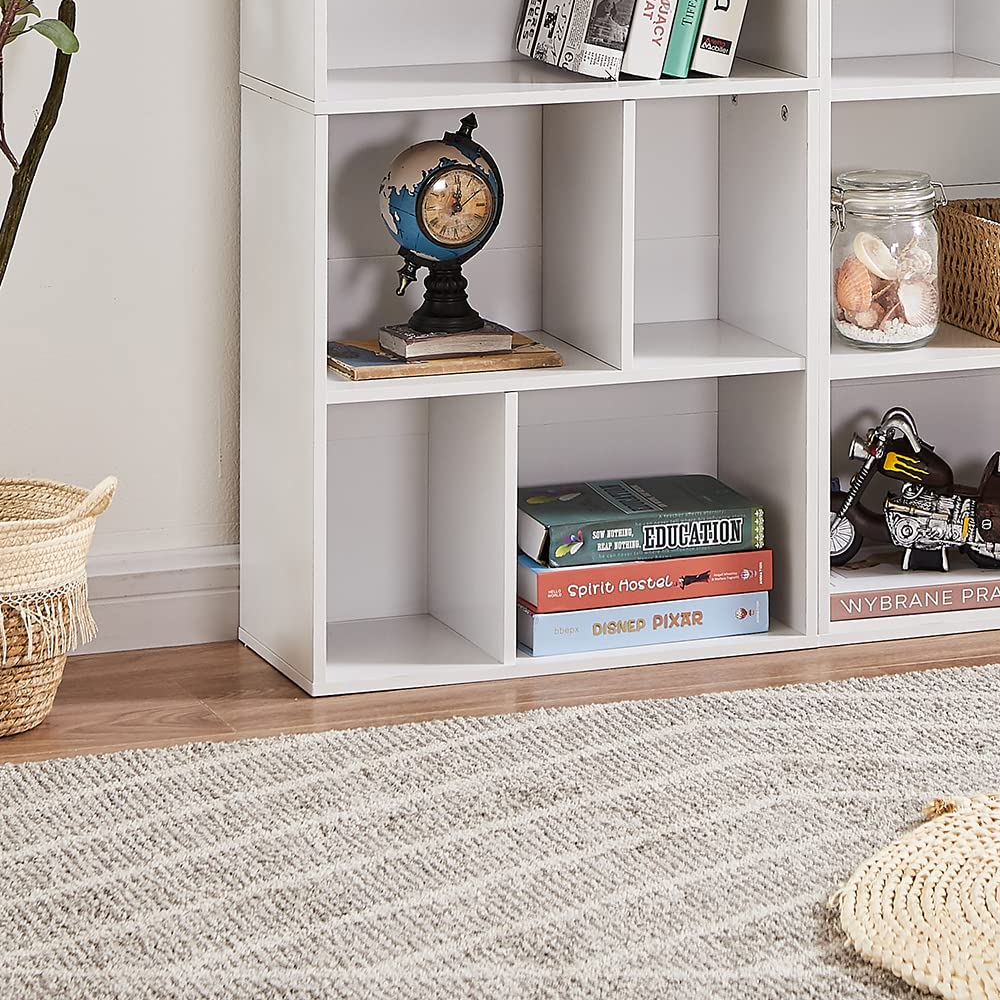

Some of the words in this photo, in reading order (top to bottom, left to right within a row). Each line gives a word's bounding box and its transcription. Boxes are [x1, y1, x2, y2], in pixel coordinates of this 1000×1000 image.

[592, 530, 606, 540] SOW
[607, 528, 634, 539] NOTHING,
[643, 517, 744, 551] EDUCATION
[597, 542, 613, 551] REAP
[567, 580, 615, 599] Spirit
[617, 575, 673, 593] Hostel
[839, 589, 954, 614] WYBRANE
[652, 610, 704, 631] PIXAR
